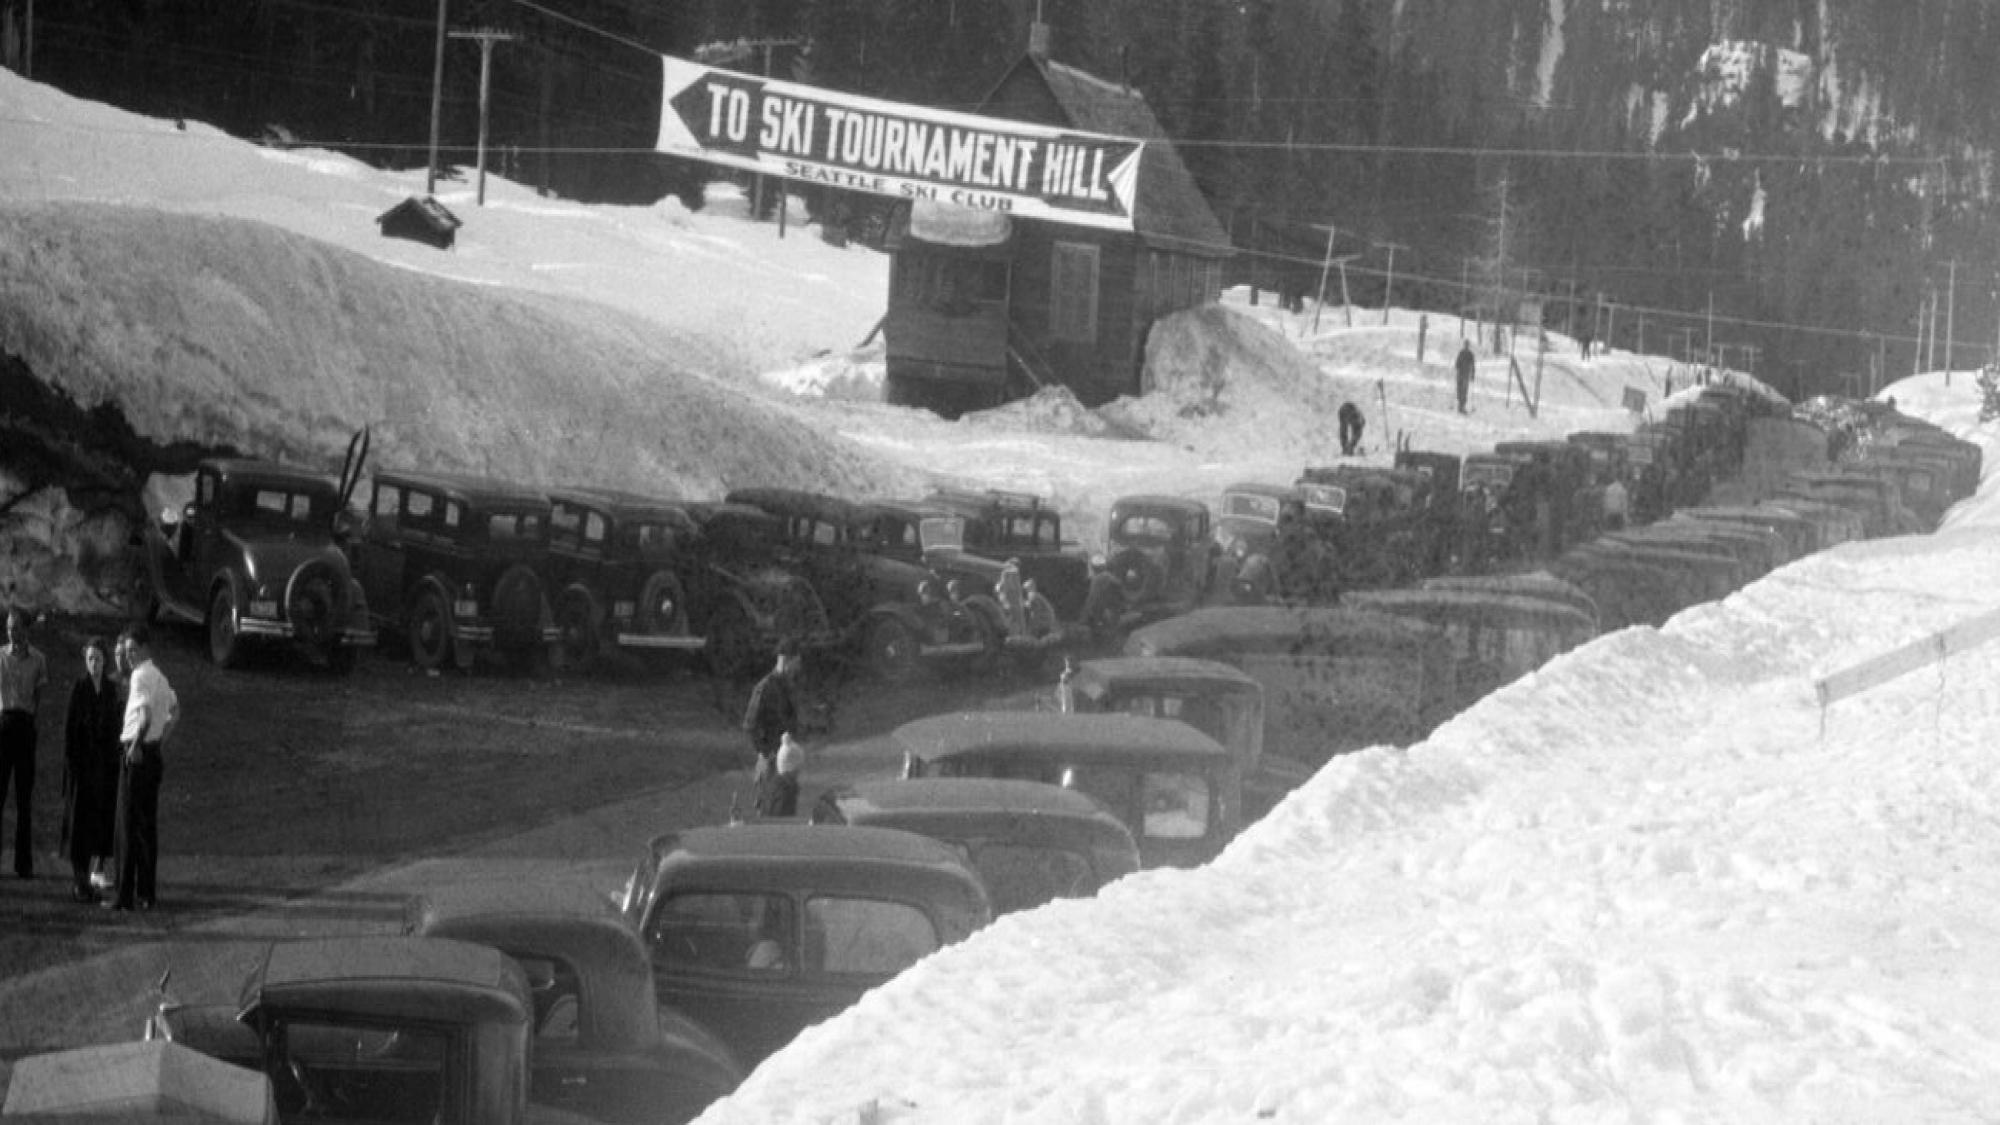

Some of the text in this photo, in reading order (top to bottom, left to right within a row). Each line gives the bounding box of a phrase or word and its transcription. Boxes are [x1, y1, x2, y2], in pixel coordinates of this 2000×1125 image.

[708, 83, 1109, 200] TO SKI TOURNAMENT HILL
[785, 161, 1012, 210] SEATTLE SKI CLUB
